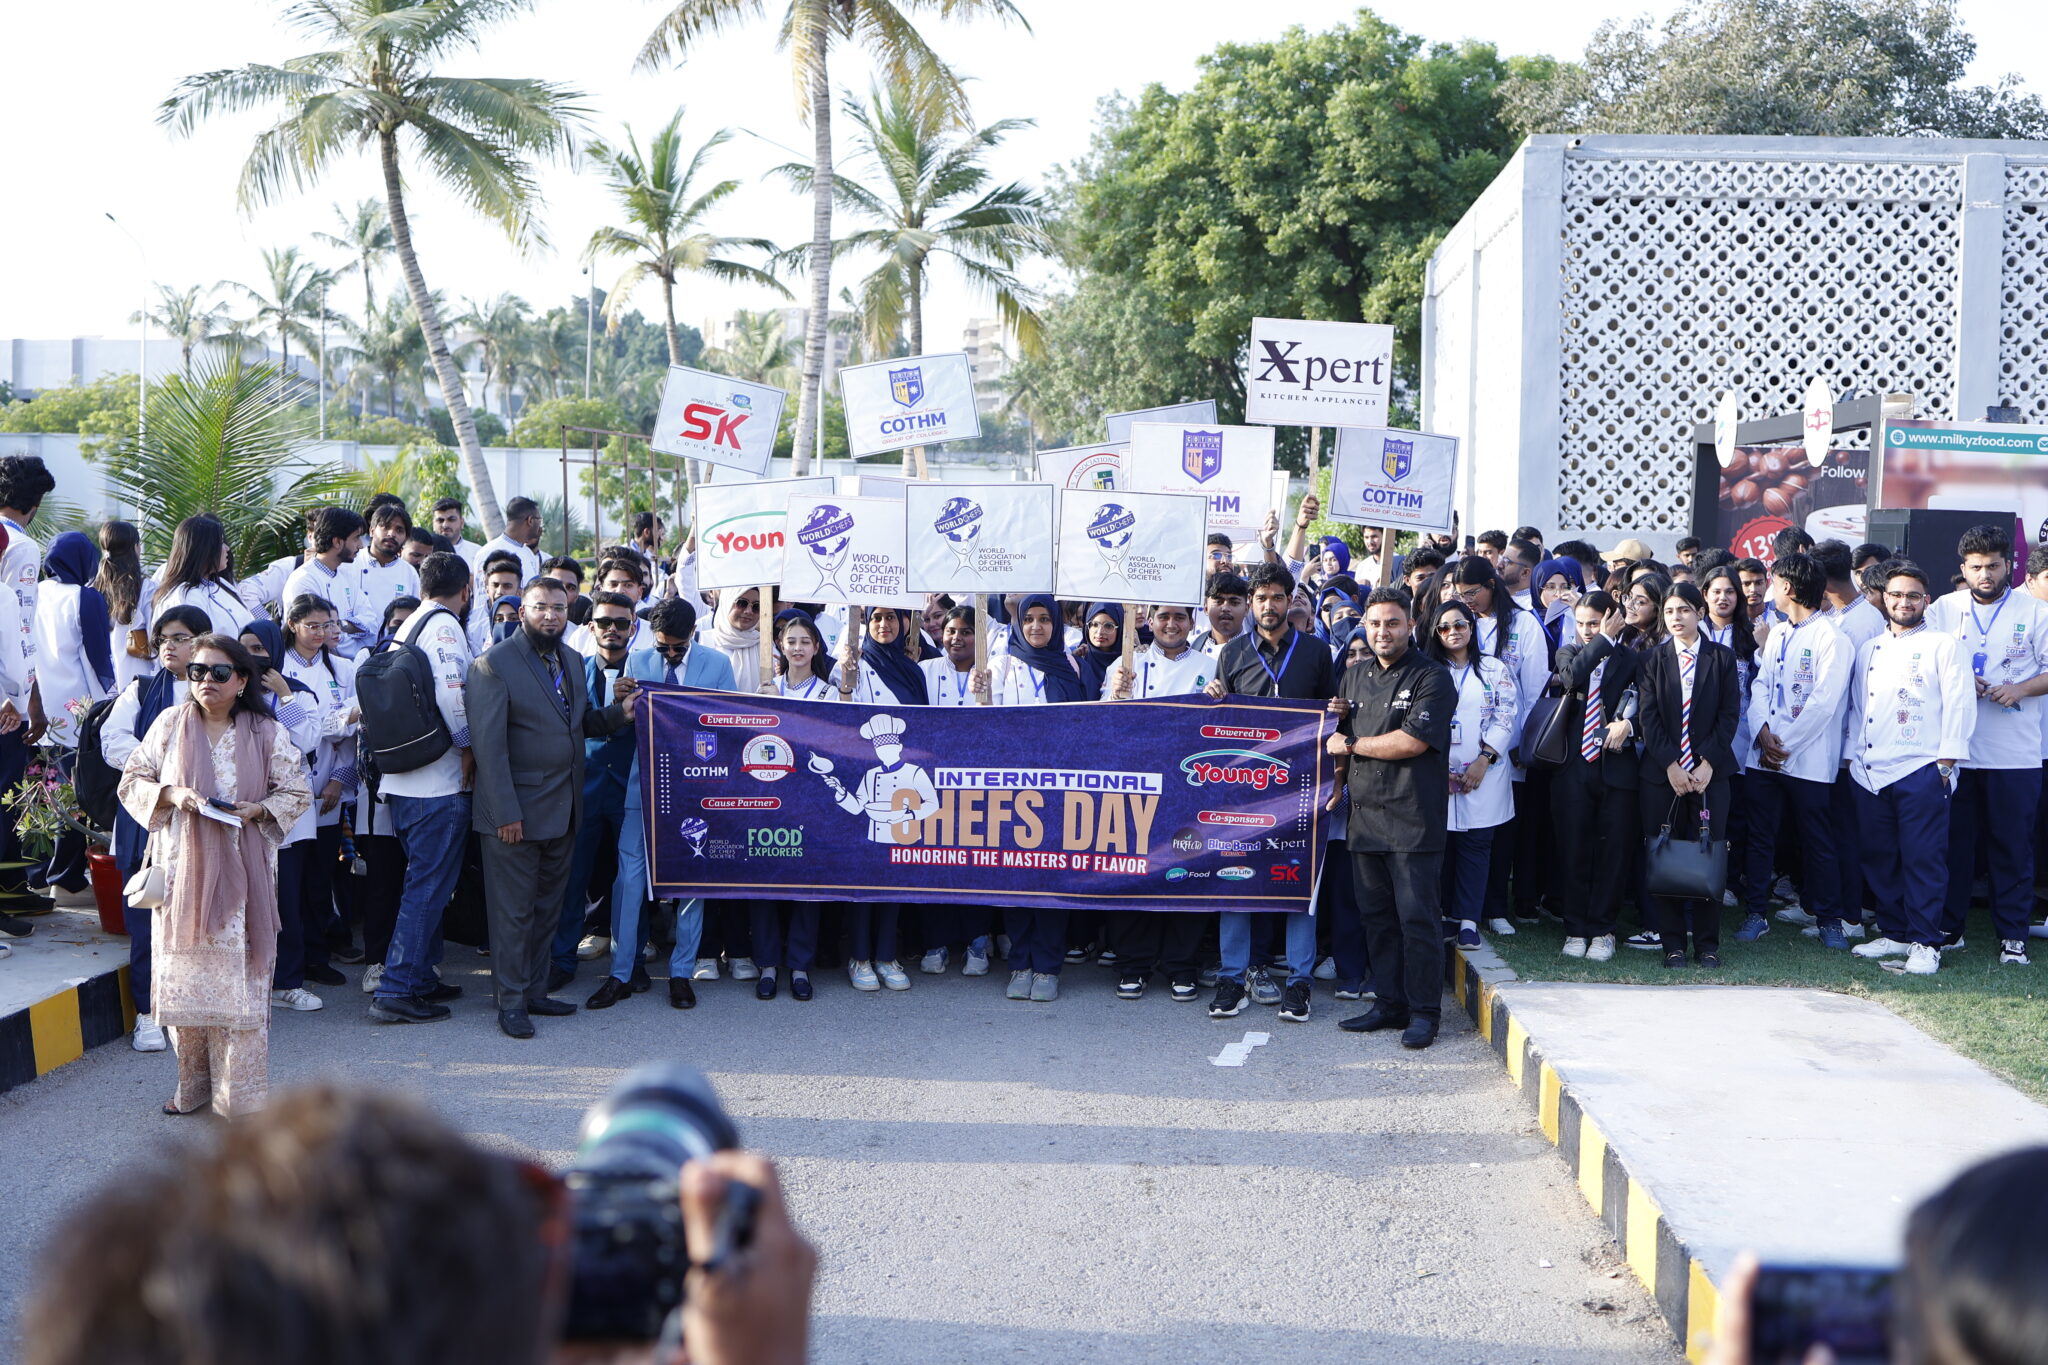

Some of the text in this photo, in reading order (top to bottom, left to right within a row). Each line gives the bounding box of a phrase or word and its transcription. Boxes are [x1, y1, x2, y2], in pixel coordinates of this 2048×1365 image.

[1255, 340, 1384, 391] Xpert
[1260, 393, 1376, 406] KITCHEN APPLANCES
[680, 403, 750, 450] SK
[880, 412, 946, 434] COTHM
[1908, 433, 2034, 449] www.milkyzfood.com
[1820, 465, 1866, 479] Follow
[1362, 488, 1423, 509] COTHM
[800, 518, 853, 544] WORLDCHEFS
[852, 553, 890, 564] WORLD
[1128, 555, 1156, 563] WORLD
[1128, 561, 1176, 570] ASSOCIATION
[850, 573, 900, 585] OF CHEFS
[1127, 573, 1162, 582] SOCIETIES
[849, 583, 899, 595] SOCIETIES
[707, 715, 772, 725] Event Partner
[1214, 728, 1267, 739] Powered by
[683, 766, 729, 777] COTHM
[759, 771, 778, 779] CAP
[1193, 762, 1289, 790] Young's
[938, 771, 1157, 791] INTERNATIONAL
[708, 799, 774, 807] Cause Partner
[891, 788, 1160, 855] CHEFS DAY
[1209, 813, 1265, 824] Co-sponsors
[747, 827, 802, 847] FOOD
[1208, 838, 1261, 851] Blue Band
[1266, 838, 1306, 851] Xpert
[748, 847, 804, 857] EXPLORERS
[891, 848, 1147, 874] HONORING THE MASTERS OF FLAVOR
[1189, 870, 1210, 878] Food
[1270, 866, 1300, 881] SK
